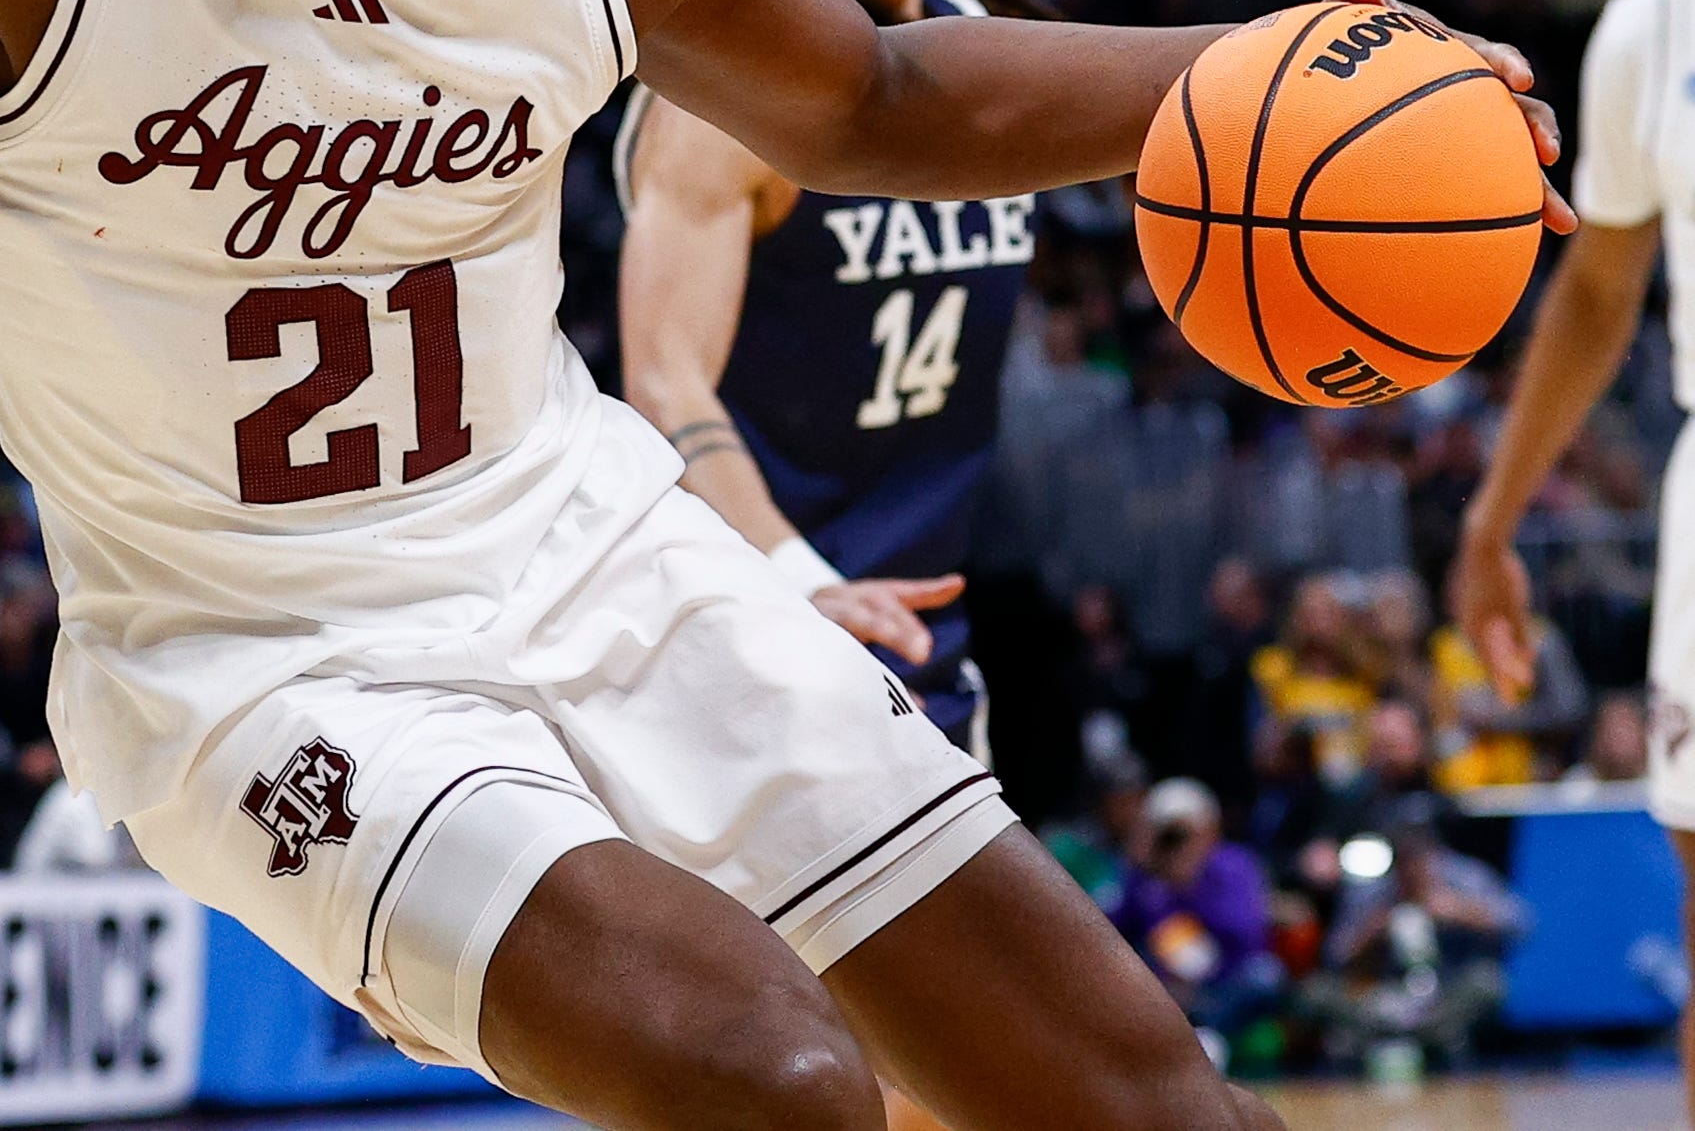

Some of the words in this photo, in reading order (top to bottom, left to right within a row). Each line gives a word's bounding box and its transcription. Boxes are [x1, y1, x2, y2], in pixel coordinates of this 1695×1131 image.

[98, 65, 542, 259] Aggies
[822, 192, 1036, 284] YALE
[225, 258, 472, 504] 21
[856, 285, 970, 430] 14
